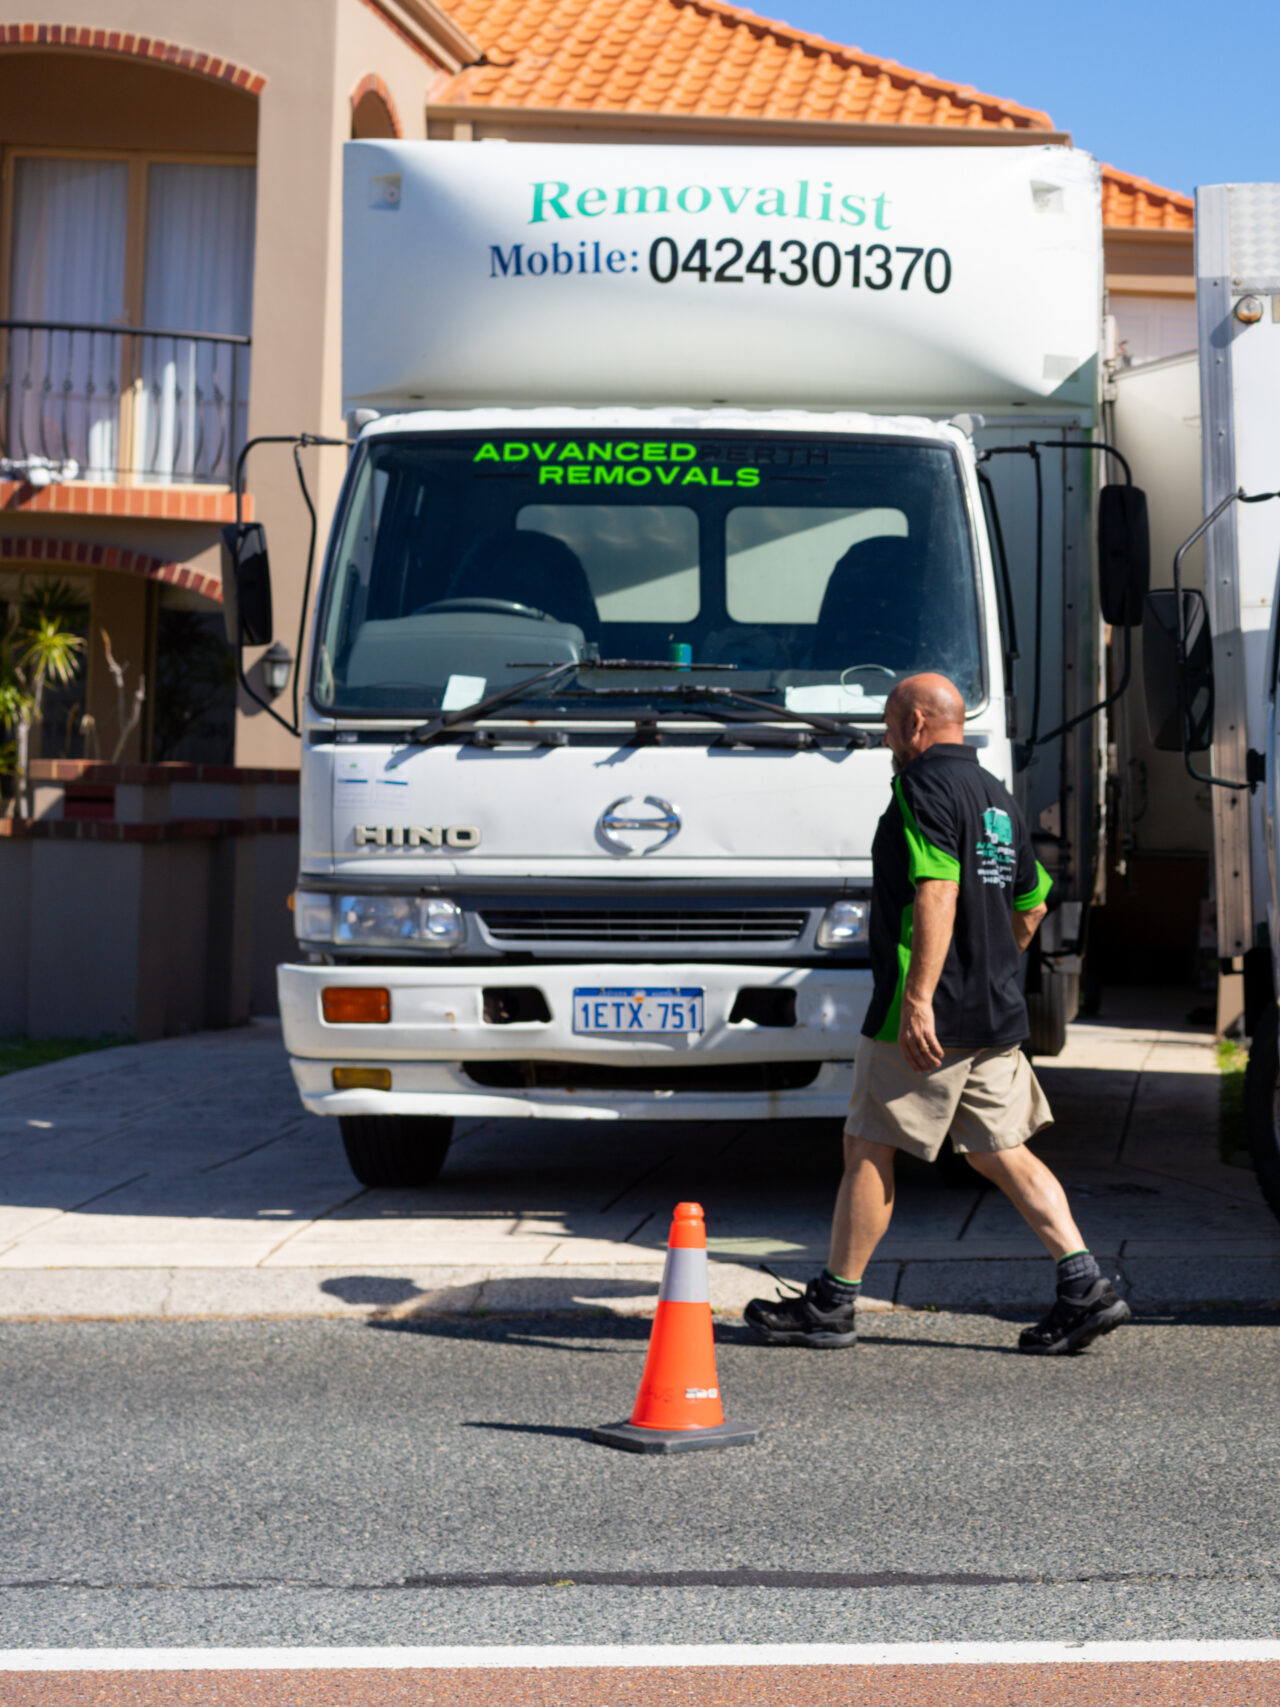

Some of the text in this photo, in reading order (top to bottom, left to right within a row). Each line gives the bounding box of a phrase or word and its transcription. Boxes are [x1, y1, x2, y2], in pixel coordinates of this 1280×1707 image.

[526, 180, 893, 231] Removalist
[489, 236, 952, 295] Mobile: 0424301370
[473, 442, 697, 463] ADVANCED
[539, 466, 760, 488] REMOVALS
[354, 824, 482, 848] HINO
